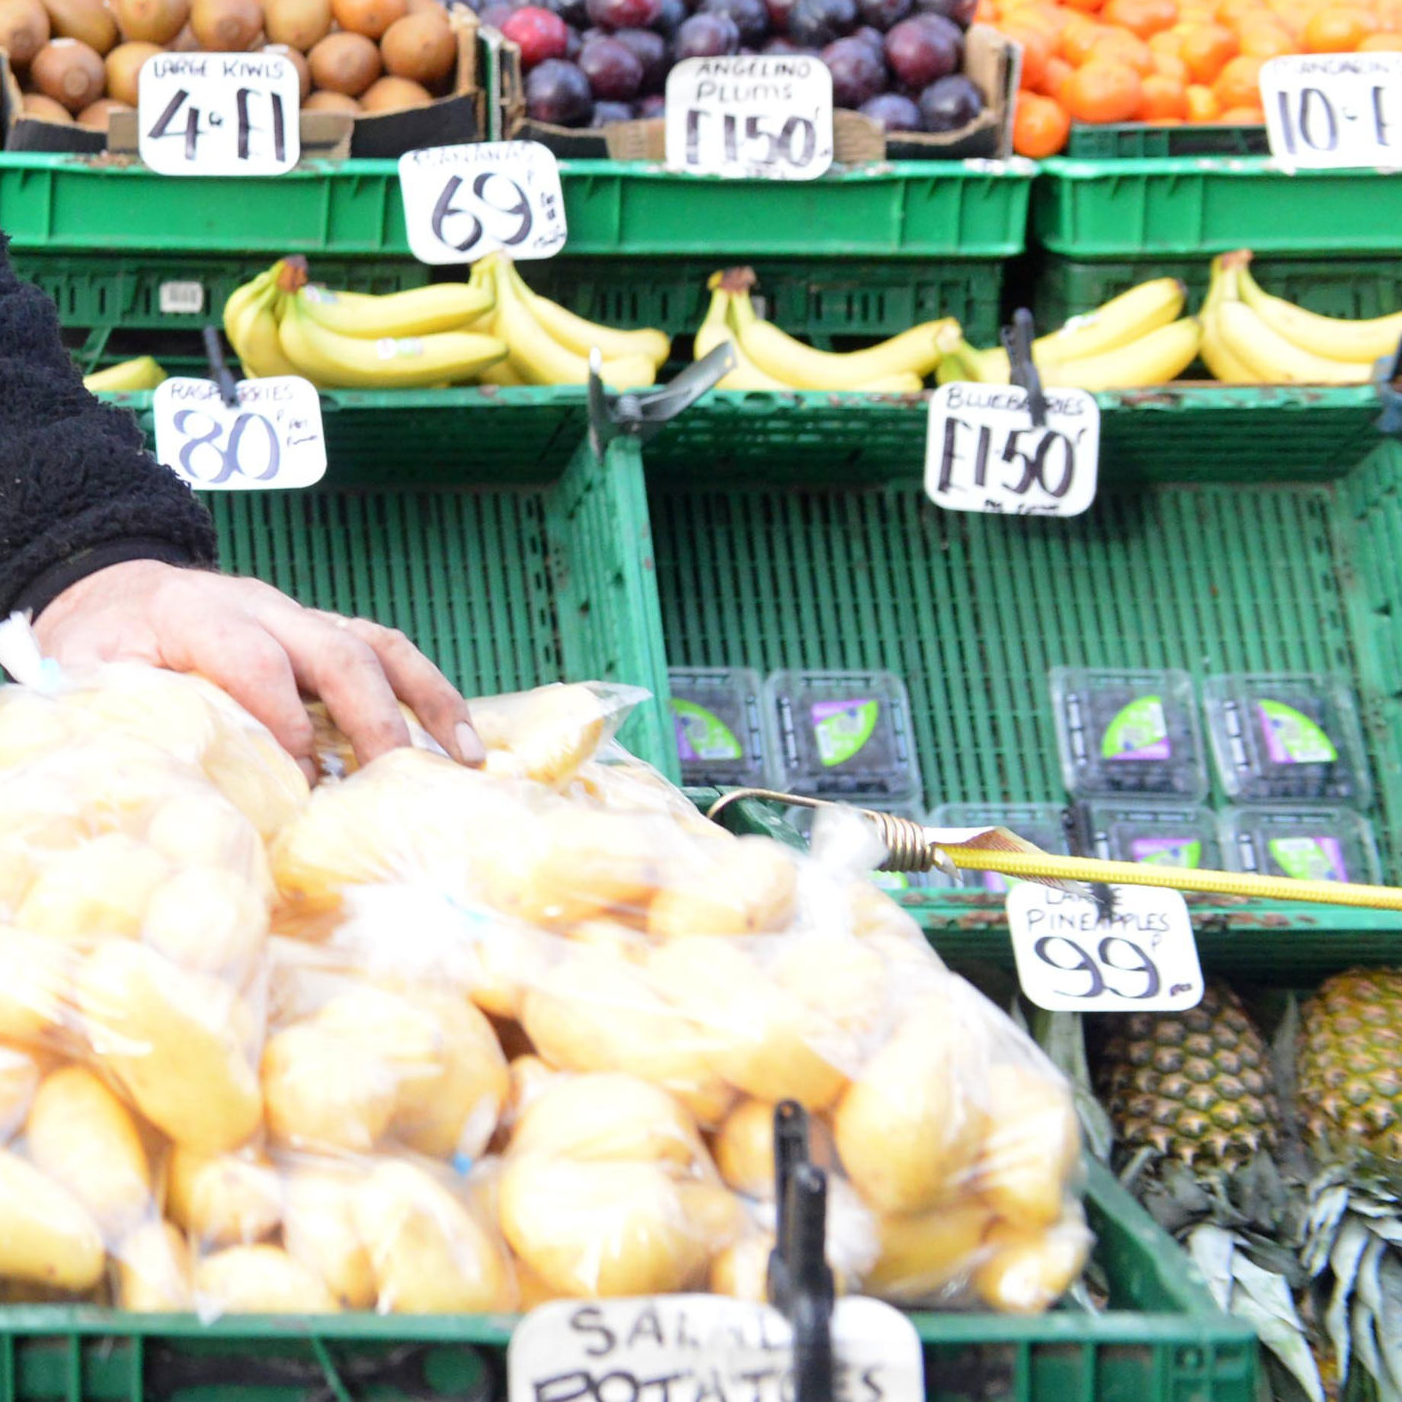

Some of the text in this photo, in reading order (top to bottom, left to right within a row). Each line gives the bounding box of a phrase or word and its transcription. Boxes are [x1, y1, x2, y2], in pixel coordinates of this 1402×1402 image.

[221, 58, 285, 80] KIWIS
[696, 60, 812, 80] ANGELINO
[431, 171, 533, 253] 69
[170, 381, 294, 401] RASPRRIES
[172, 409, 281, 485] 80
[1025, 908, 1171, 932] PINEAPPLES
[1033, 936, 1161, 1000] 99
